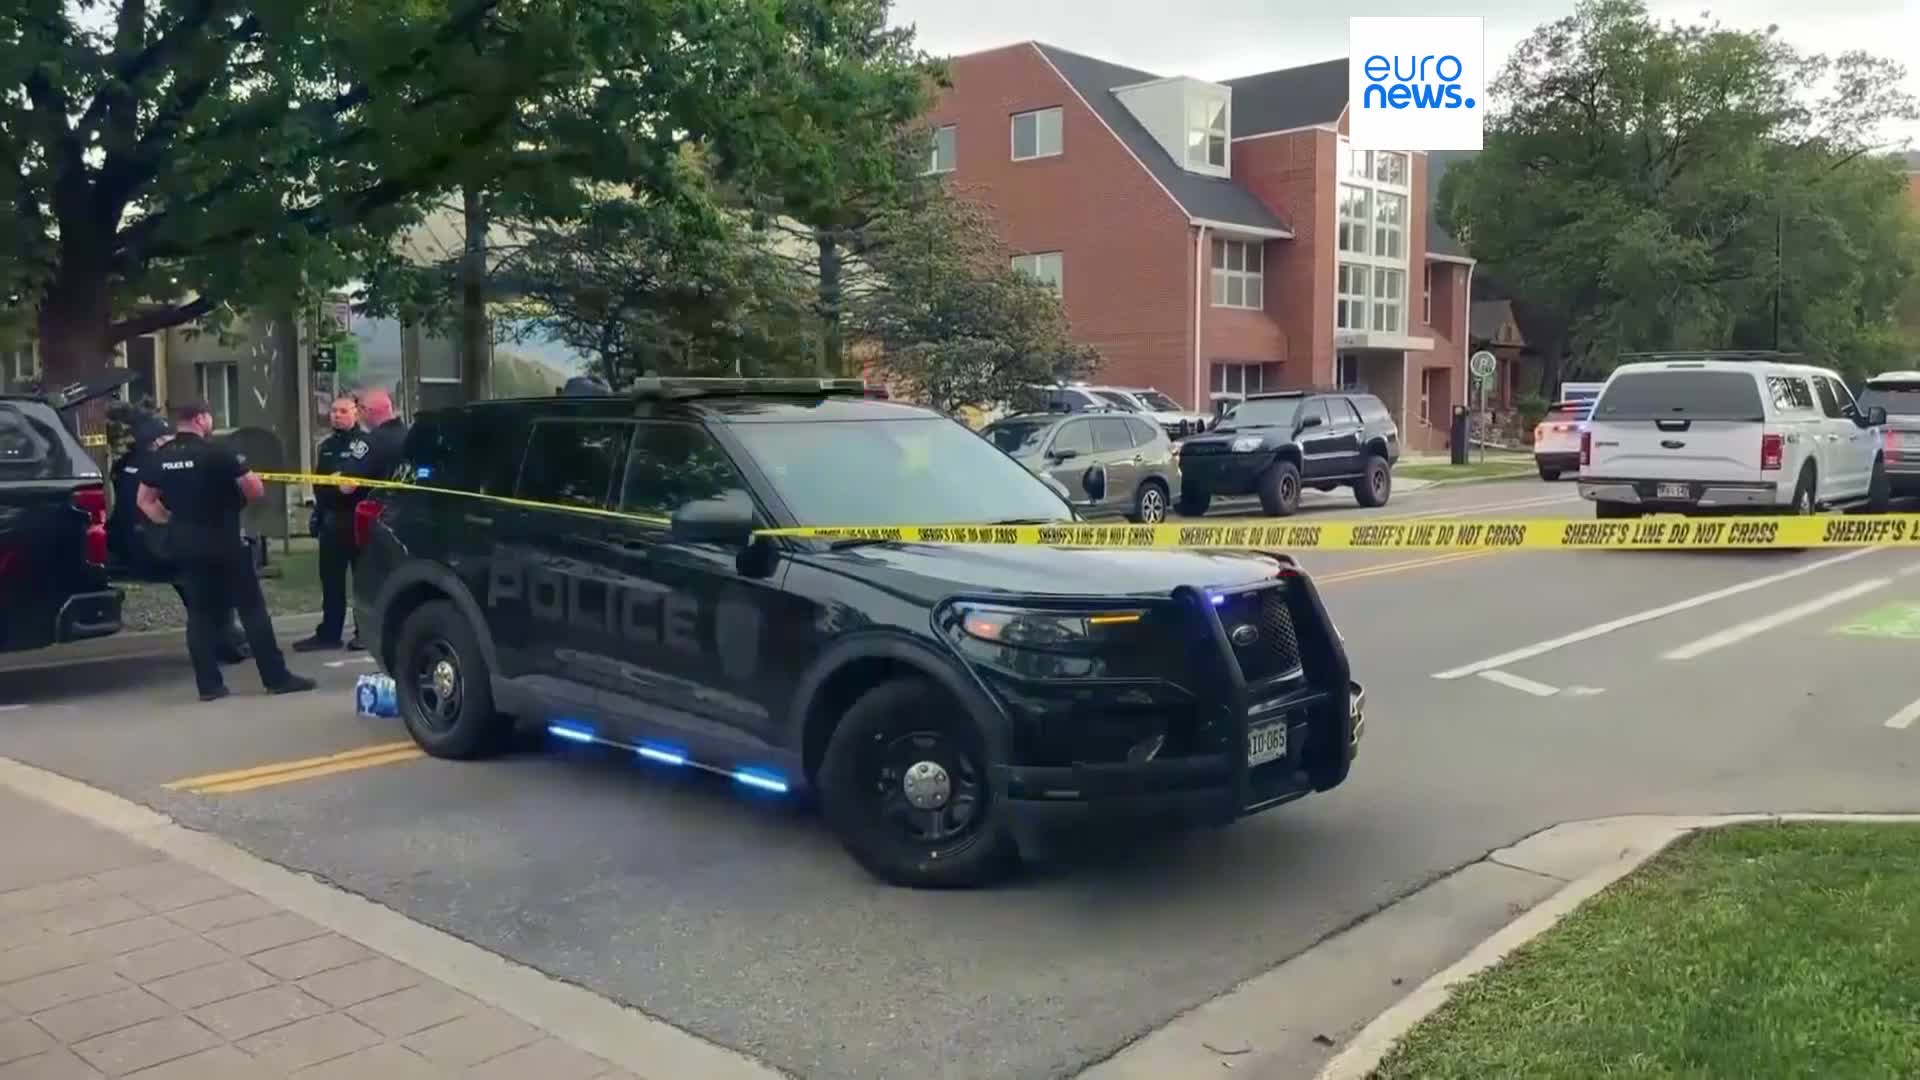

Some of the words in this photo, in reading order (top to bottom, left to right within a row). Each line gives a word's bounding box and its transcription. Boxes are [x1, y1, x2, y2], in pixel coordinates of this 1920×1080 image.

[162, 461, 185, 470] POLICE
[1178, 528, 1224, 545] SHERIFF'S
[1225, 528, 1248, 545] LINE
[1250, 528, 1264, 545] DO
[1265, 528, 1286, 545] NOT
[1287, 527, 1322, 546] CROSS
[1349, 526, 1405, 546] SHERIFF'S
[1406, 525, 1436, 545] LINE
[1436, 525, 1454, 545] DO
[1456, 525, 1483, 545] NOT
[1484, 524, 1527, 546] CROSS
[1561, 524, 1629, 545] SHERIFF'S
[1631, 523, 1665, 544] LINE
[1668, 523, 1690, 543] DO
[1692, 523, 1726, 543] NOT
[1727, 522, 1778, 544] CROSS
[1822, 519, 1906, 542] SHERIFF'S
[487, 552, 702, 652] POLICE
